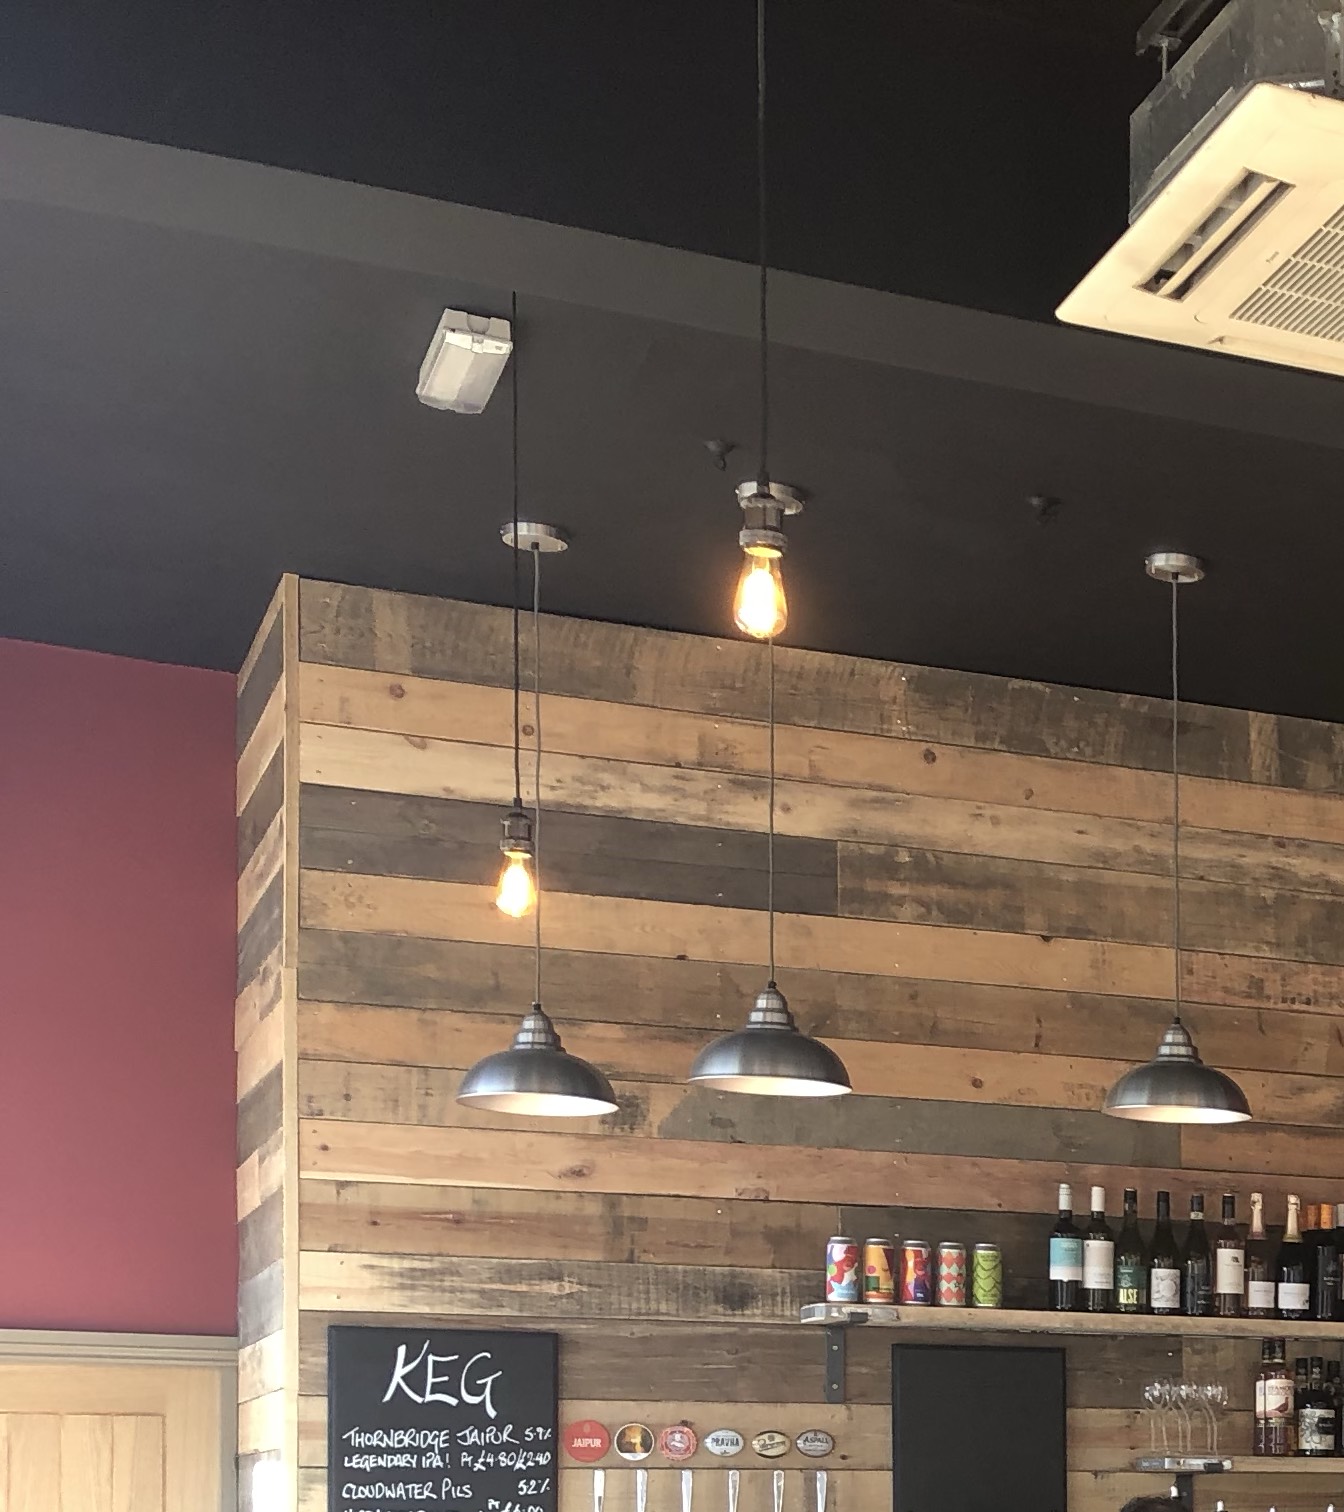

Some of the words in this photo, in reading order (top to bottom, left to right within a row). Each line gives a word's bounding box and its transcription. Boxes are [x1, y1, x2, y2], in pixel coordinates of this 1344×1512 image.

[382, 1340, 502, 1419] KEG
[342, 1427, 449, 1453] THORNBRIDGE
[456, 1424, 520, 1446] JAIPUR
[572, 1437, 602, 1448] JAIPUR
[711, 1437, 740, 1447] PRAVHA
[344, 1453, 418, 1472] LEGENDARY
[342, 1481, 438, 1500] CLOUDWATER
